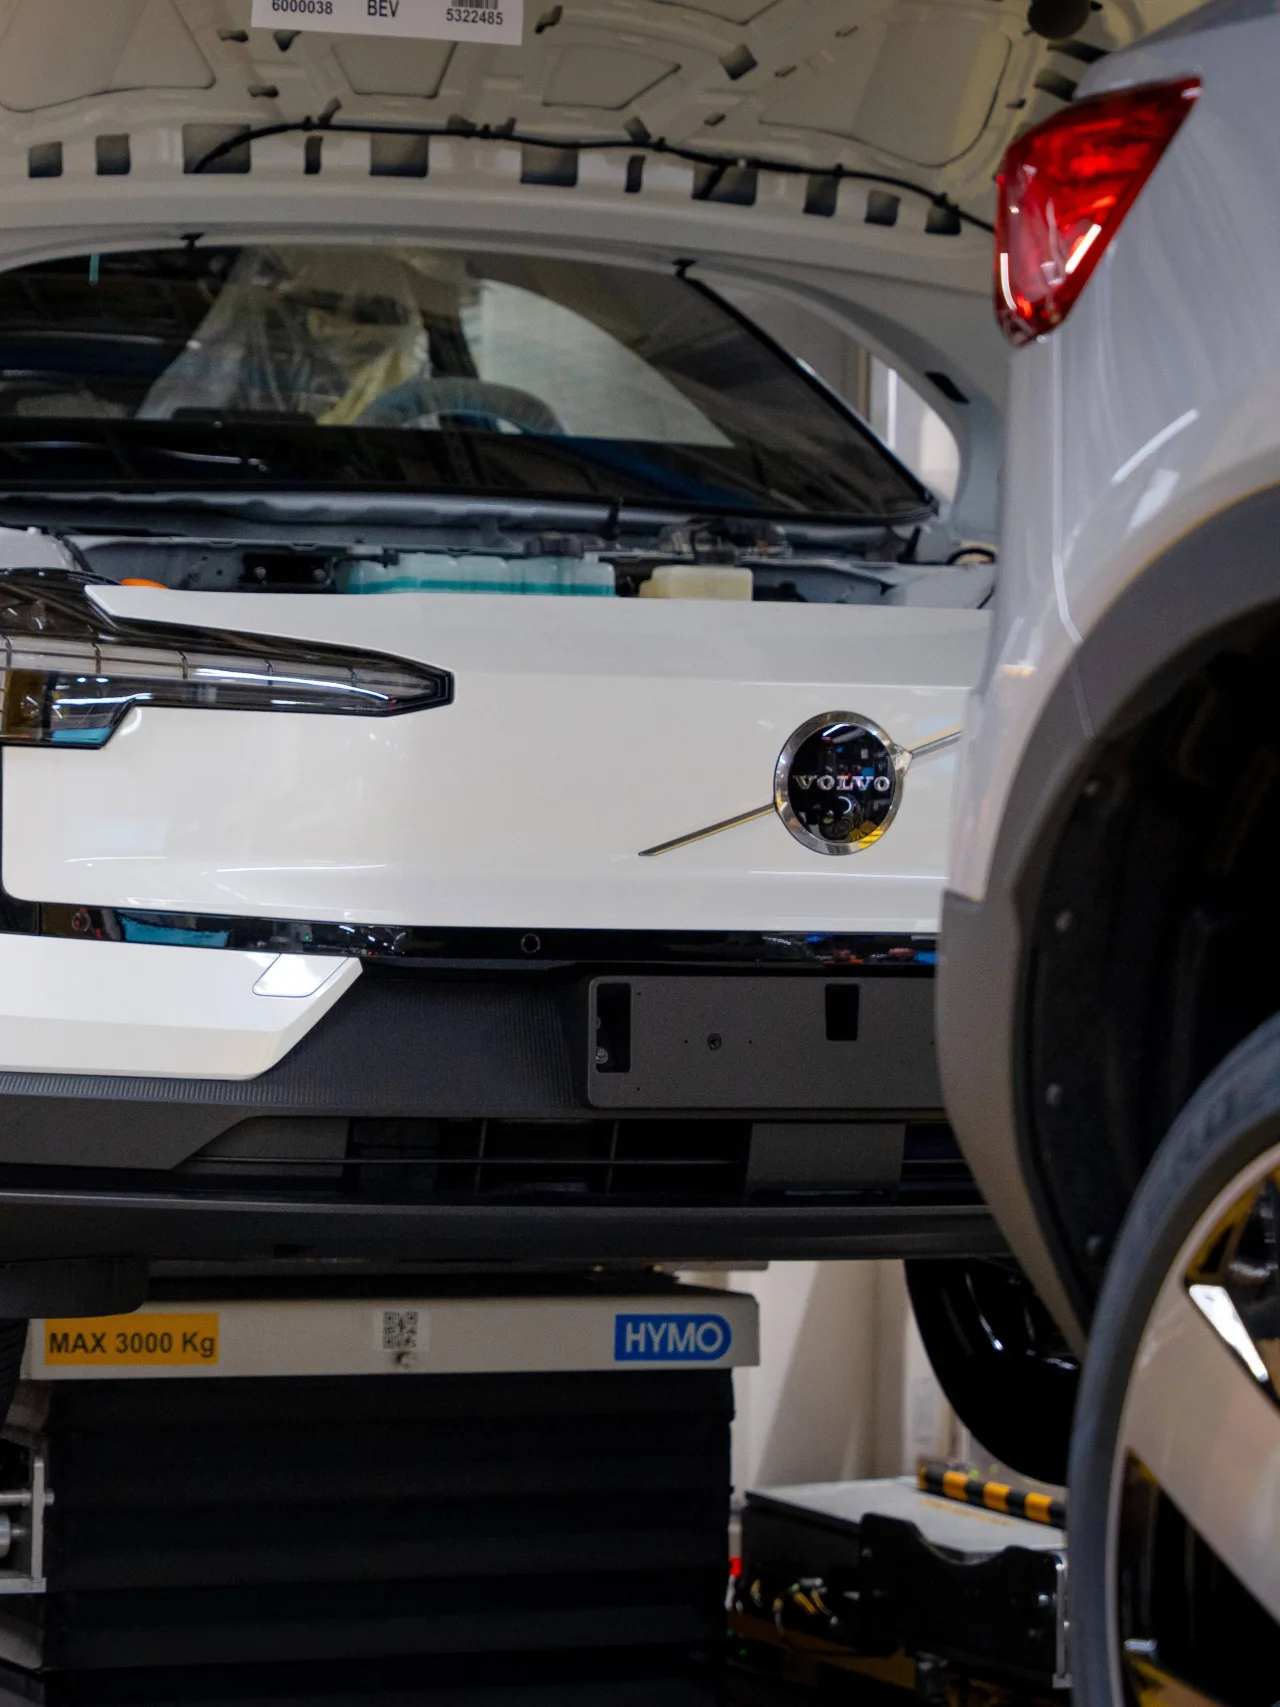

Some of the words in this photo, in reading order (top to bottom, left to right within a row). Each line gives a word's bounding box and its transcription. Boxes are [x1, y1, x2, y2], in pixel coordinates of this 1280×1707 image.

[272, 0, 333, 15] 6000038
[366, 0, 400, 18] BEV
[445, 8, 504, 26] 5322485
[793, 774, 891, 792] VOLVO
[49, 1332, 108, 1354] MAX
[115, 1332, 173, 1354] 3000
[181, 1331, 216, 1358] Kg
[625, 1321, 724, 1353] HYMO
